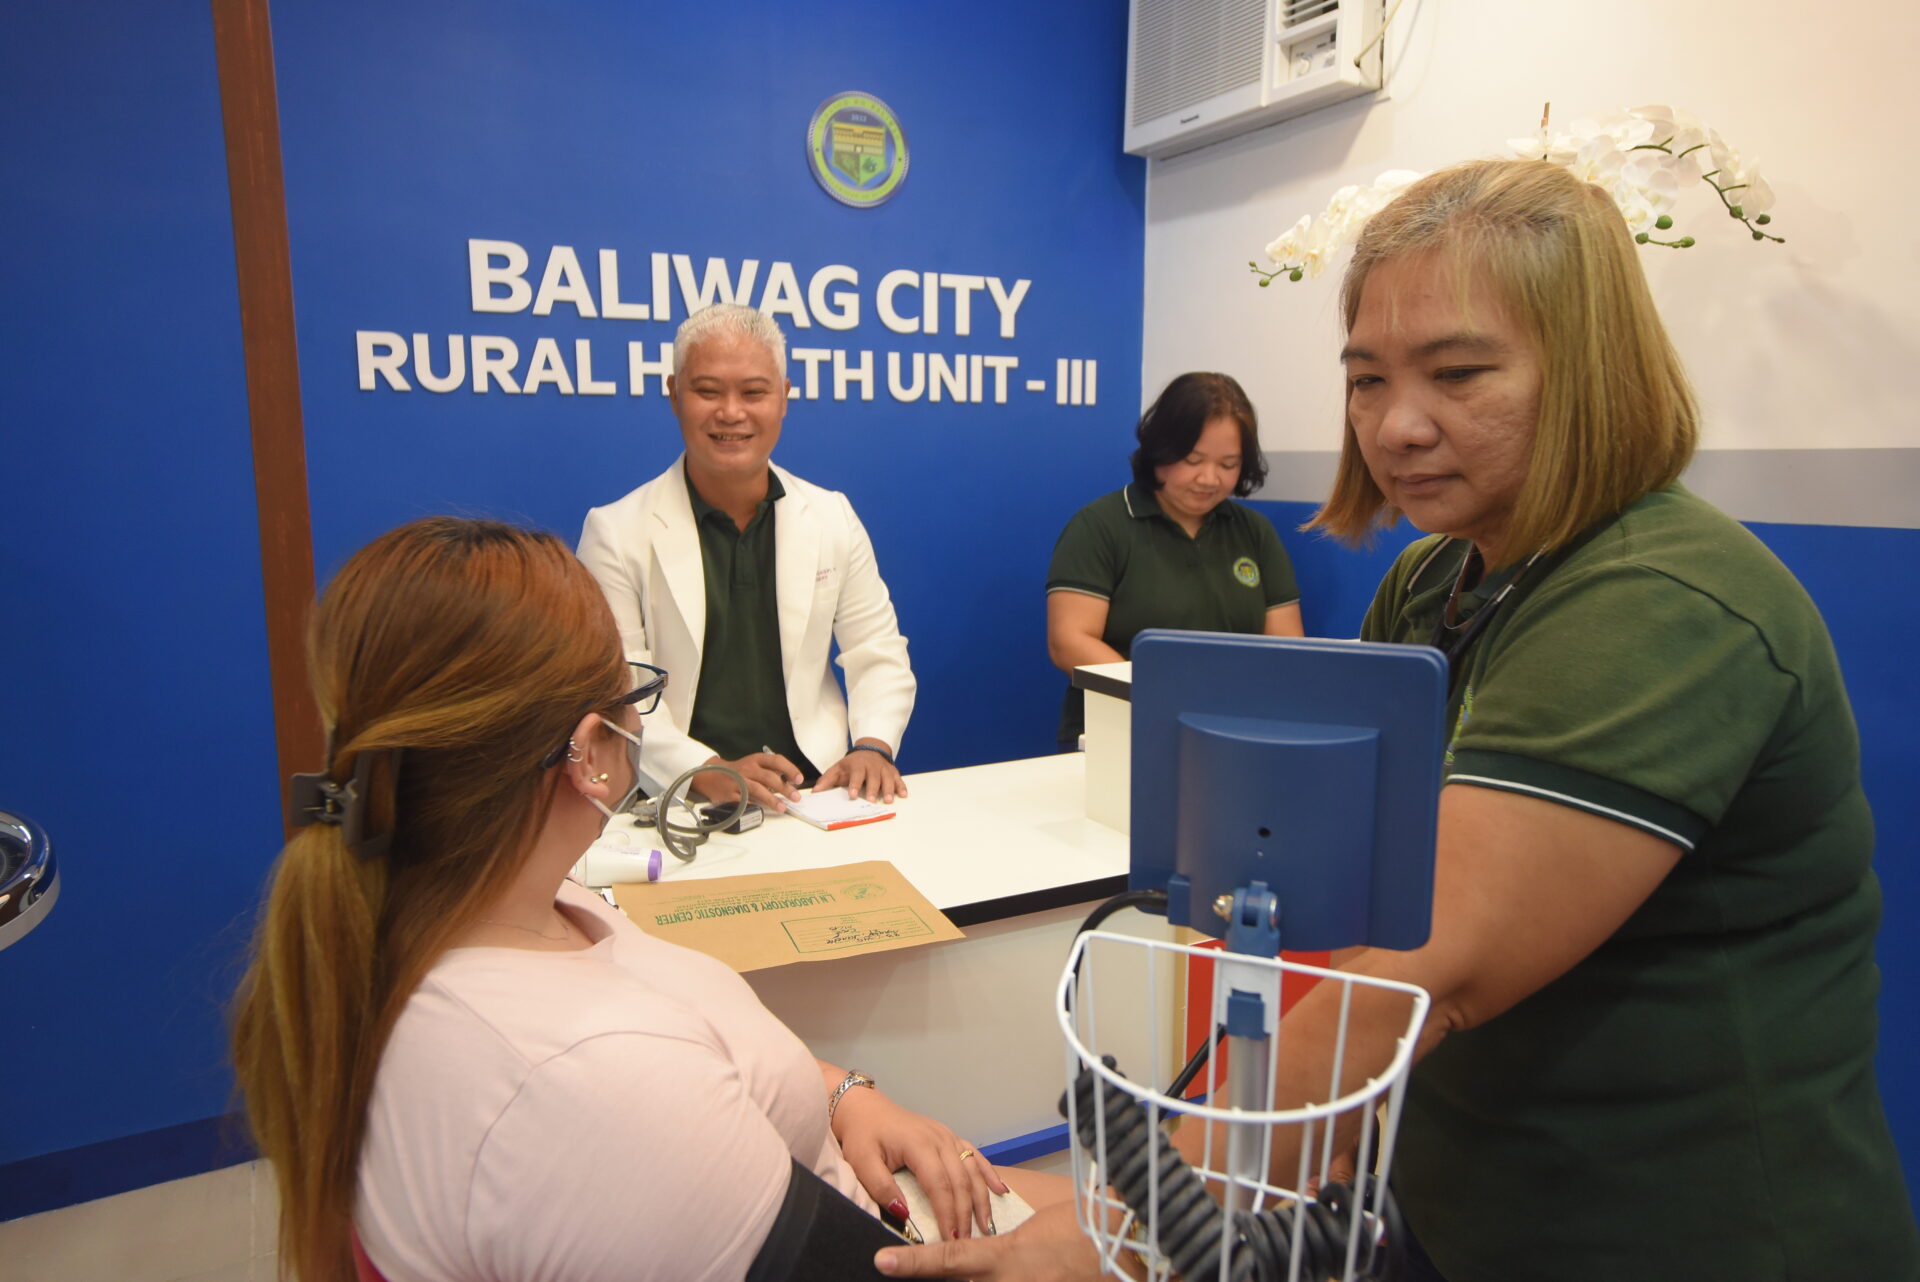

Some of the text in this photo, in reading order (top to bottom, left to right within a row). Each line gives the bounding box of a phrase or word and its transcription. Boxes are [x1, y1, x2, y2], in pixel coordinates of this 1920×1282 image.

[468, 238, 1032, 339] BALIWAG CITY
[356, 330, 1097, 406] RURAL HTH UNIT - III
[753, 901, 760, 912] &
[761, 896, 820, 912] LABORATORY
[655, 913, 693, 926] CENTER
[694, 905, 751, 920] DIAGNOSTIC
